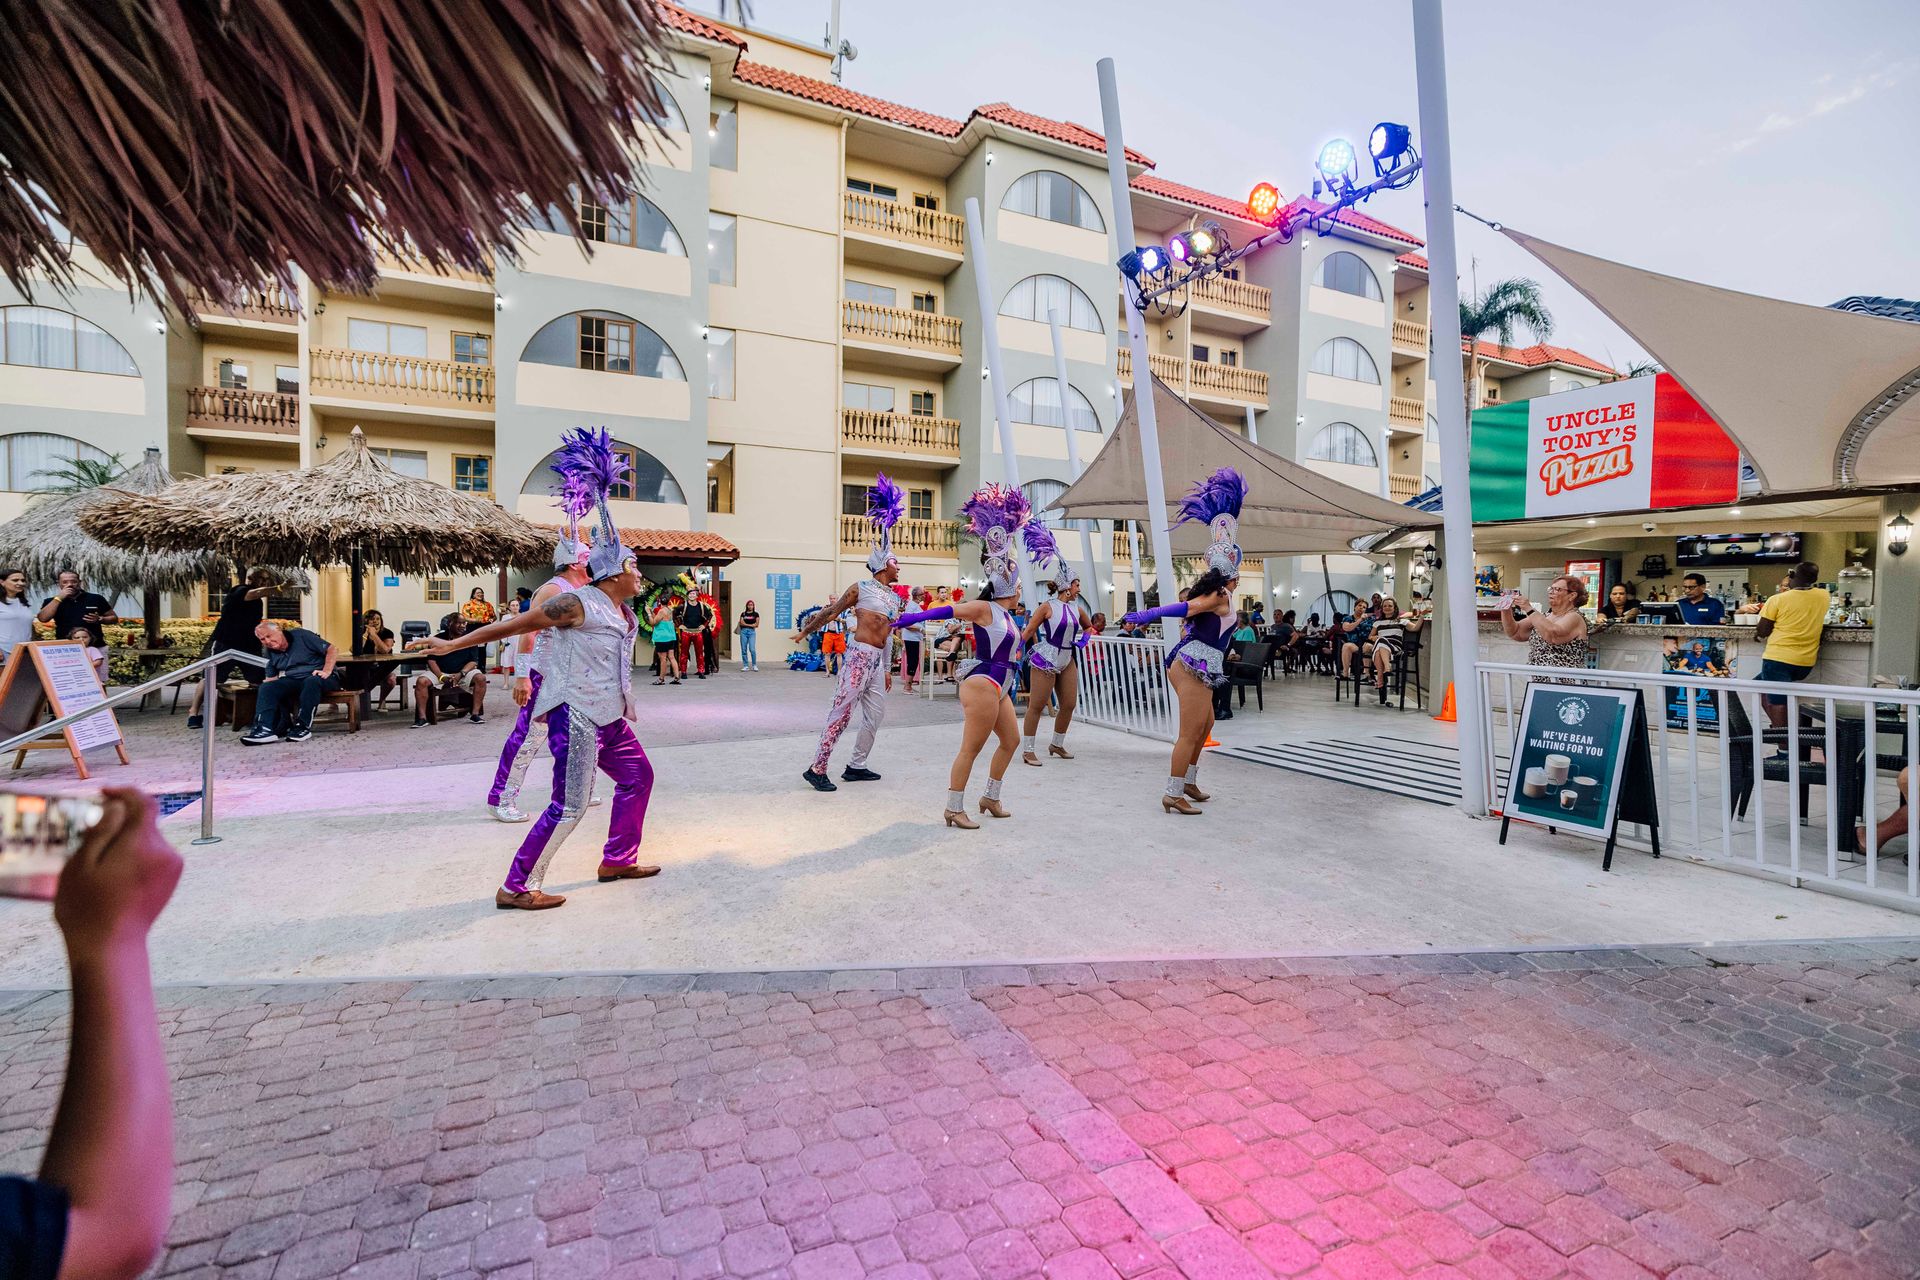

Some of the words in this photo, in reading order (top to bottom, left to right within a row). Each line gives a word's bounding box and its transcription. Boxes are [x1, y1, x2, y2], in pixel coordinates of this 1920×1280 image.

[1546, 402, 1635, 432] UNCLE
[1543, 425, 1637, 454] TONY'S
[1541, 445, 1633, 495] Pizza
[1530, 738, 1565, 751] WAITING
[1566, 743, 1583, 754] FOR
[1585, 746, 1603, 757] YOU
[1542, 730, 1569, 742] WE'VE
[1569, 733, 1594, 745] BEAN
